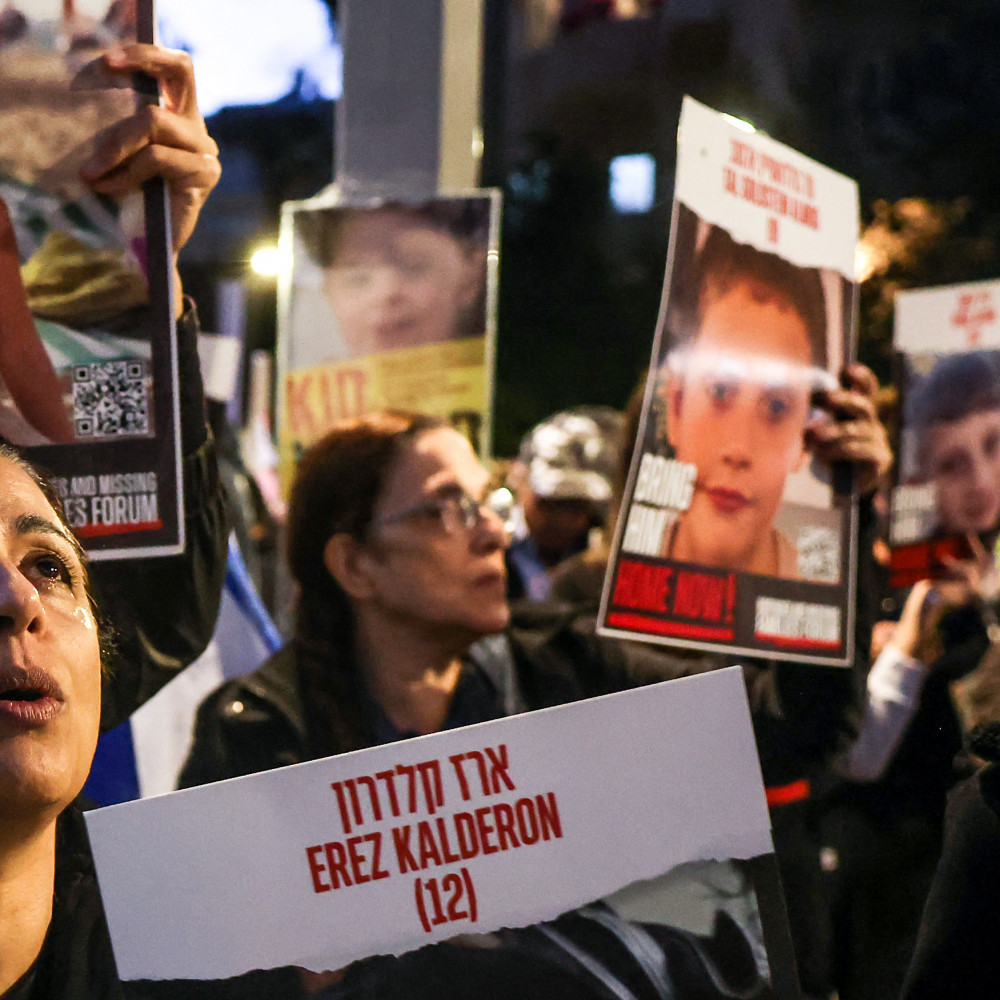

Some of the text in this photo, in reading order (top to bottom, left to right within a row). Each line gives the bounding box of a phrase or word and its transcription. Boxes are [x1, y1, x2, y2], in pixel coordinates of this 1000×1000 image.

[91, 493, 159, 527] FORUM
[98, 471, 158, 495] MISSING
[330, 744, 516, 834] ארז קלדרון
[305, 792, 563, 893] EREZ KALDERON
[414, 867, 478, 932] (12)
